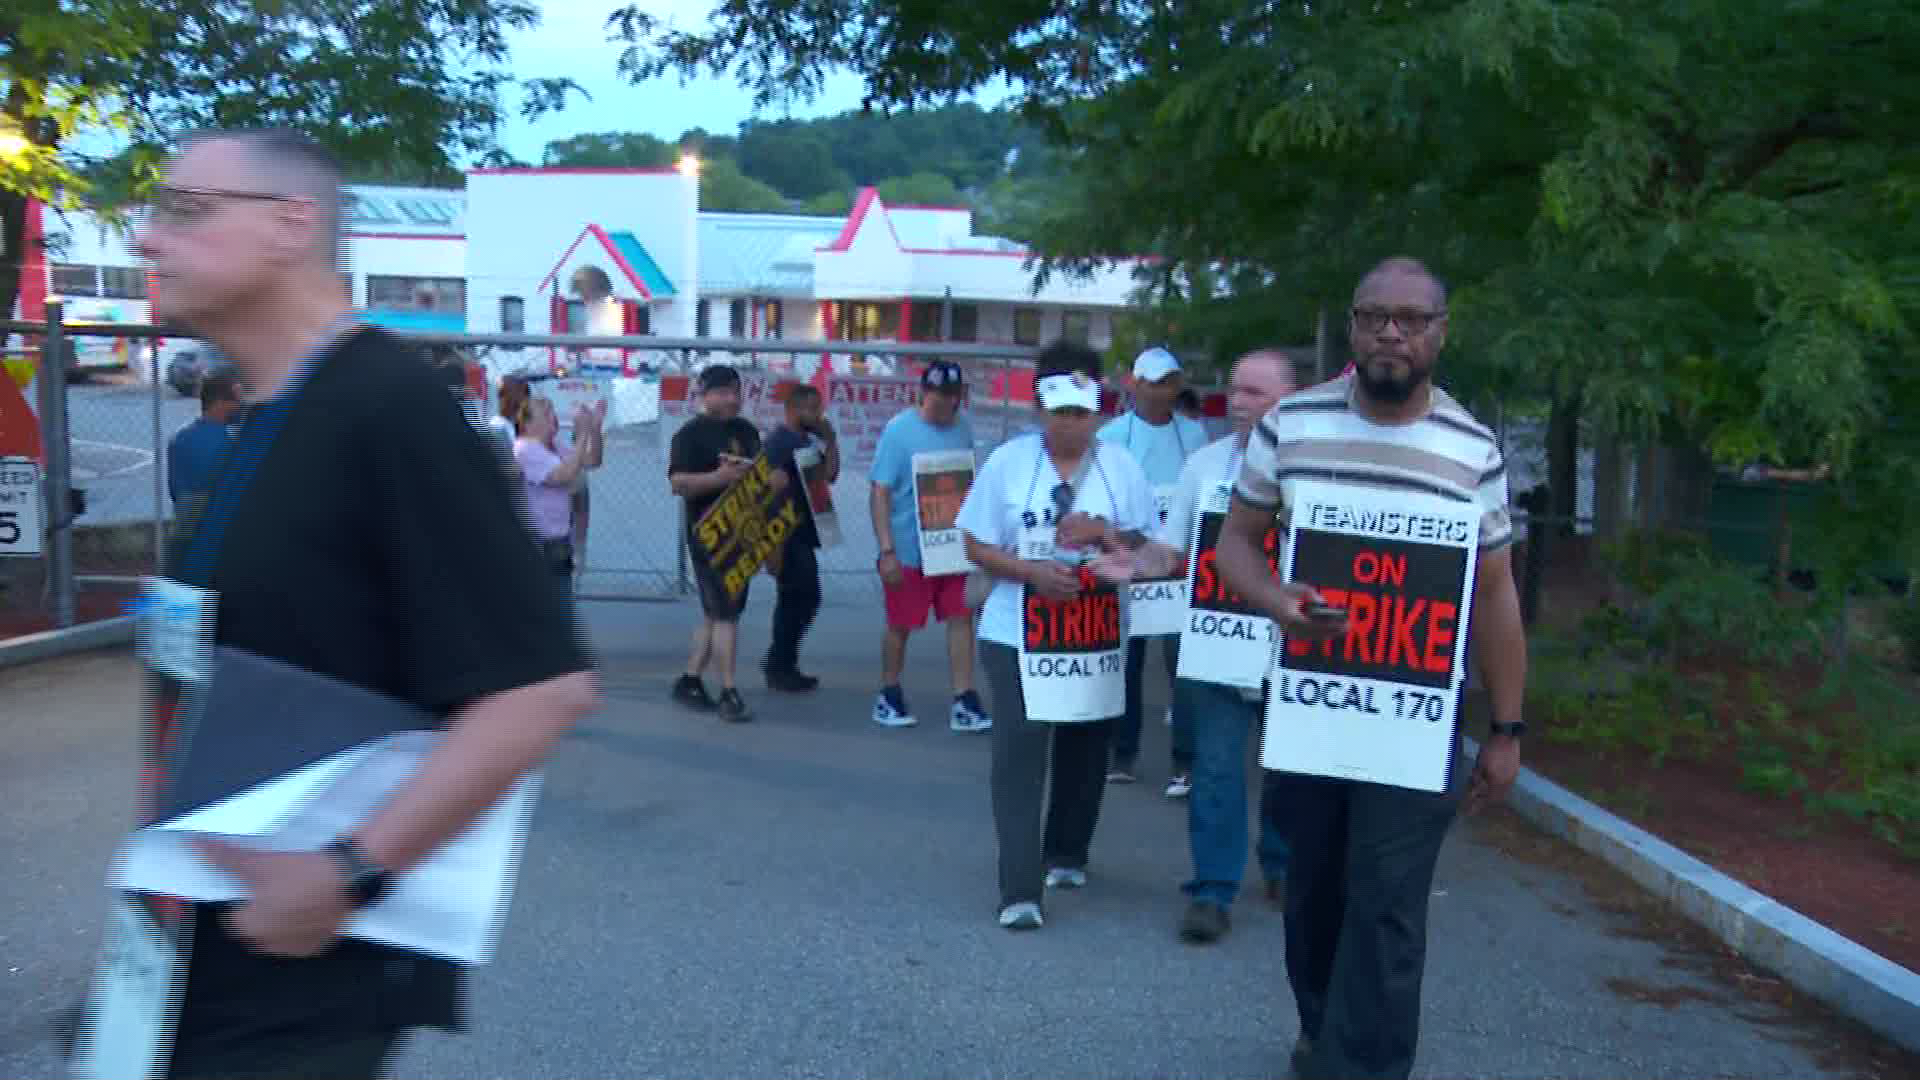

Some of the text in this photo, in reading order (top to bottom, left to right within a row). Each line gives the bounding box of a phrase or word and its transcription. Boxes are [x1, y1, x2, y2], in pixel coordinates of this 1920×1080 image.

[697, 455, 772, 552] STRIKE
[1310, 504, 1468, 541] TEAMSTERS
[1353, 551, 1406, 587] ON
[1192, 614, 1256, 641] LOCAL
[1028, 656, 1094, 677] LOCAL
[1280, 677, 1443, 722] LOCAL 170
